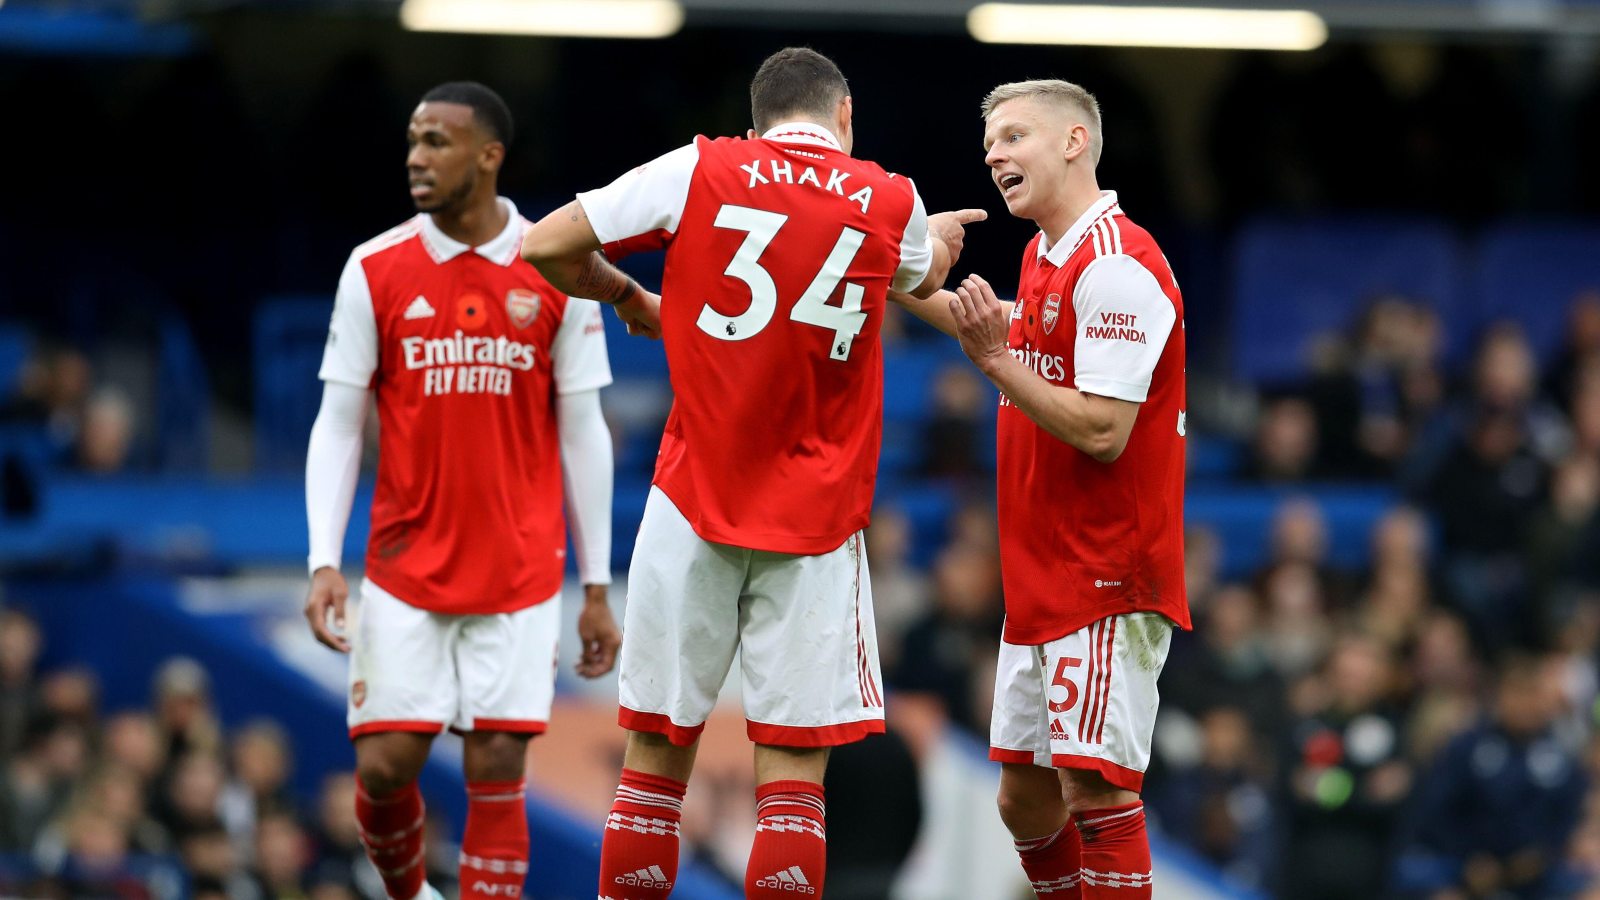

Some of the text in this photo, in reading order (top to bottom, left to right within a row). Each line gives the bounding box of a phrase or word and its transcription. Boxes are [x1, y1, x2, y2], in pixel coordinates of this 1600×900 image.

[740, 159, 873, 213] XHAKA
[696, 204, 867, 361] 34
[1100, 312, 1137, 327] VISIT
[1085, 326, 1147, 345] RWANDA
[402, 328, 536, 371] Emirates
[424, 365, 512, 397] FLY BETTER
[614, 875, 673, 891] adidas
[755, 876, 816, 895] adidas
